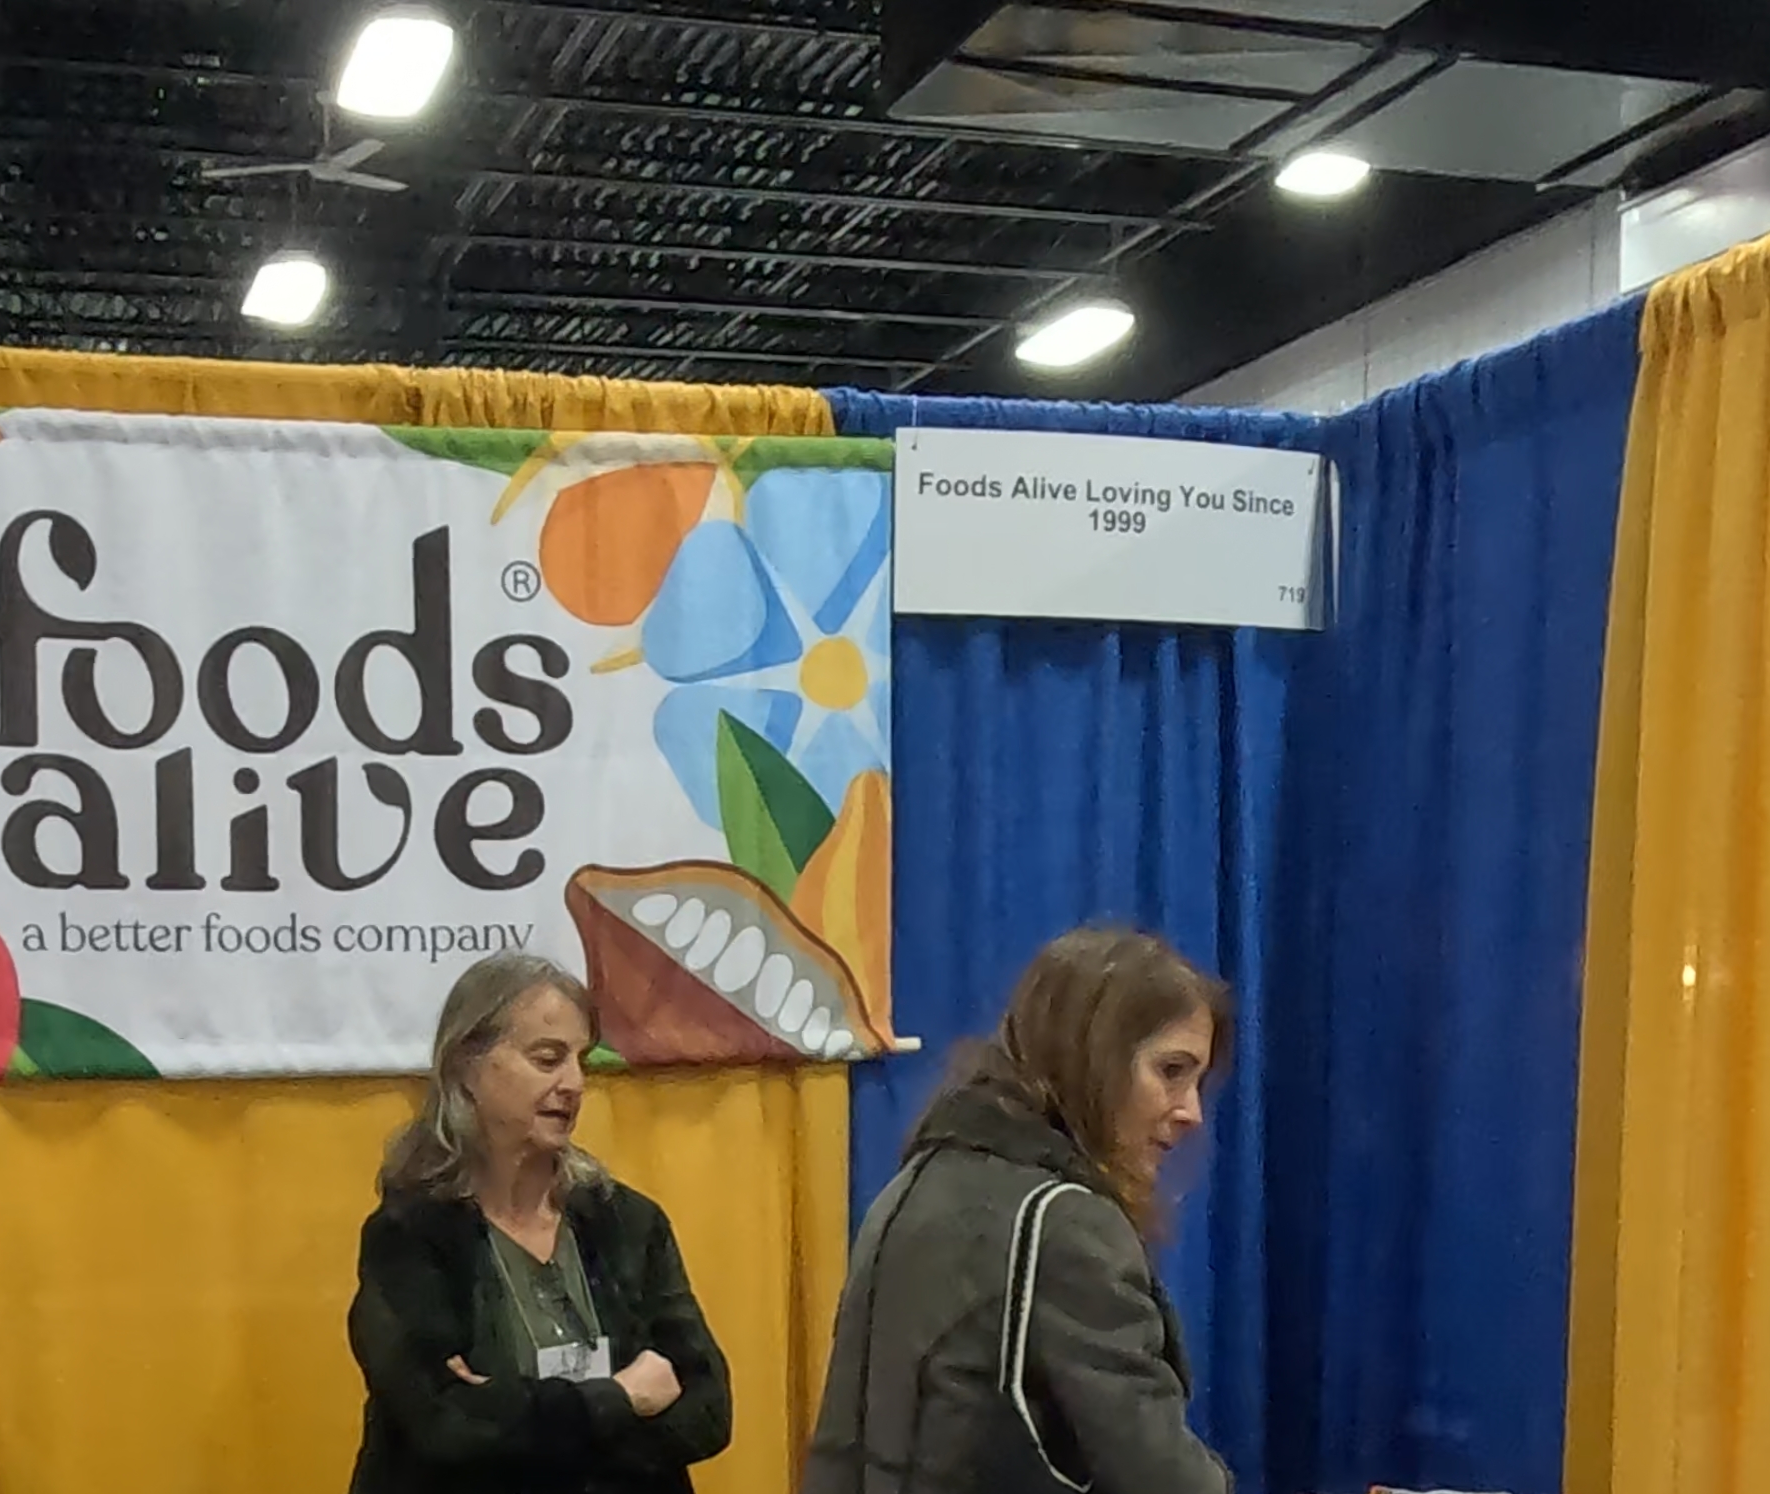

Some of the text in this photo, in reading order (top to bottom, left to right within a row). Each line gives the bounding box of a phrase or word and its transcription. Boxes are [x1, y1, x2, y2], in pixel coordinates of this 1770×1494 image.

[918, 473, 1295, 516] Foods Alive Loving You Since
[1089, 510, 1146, 533] 1999
[0, 747, 546, 890] alive
[22, 912, 534, 962] a better foods company
